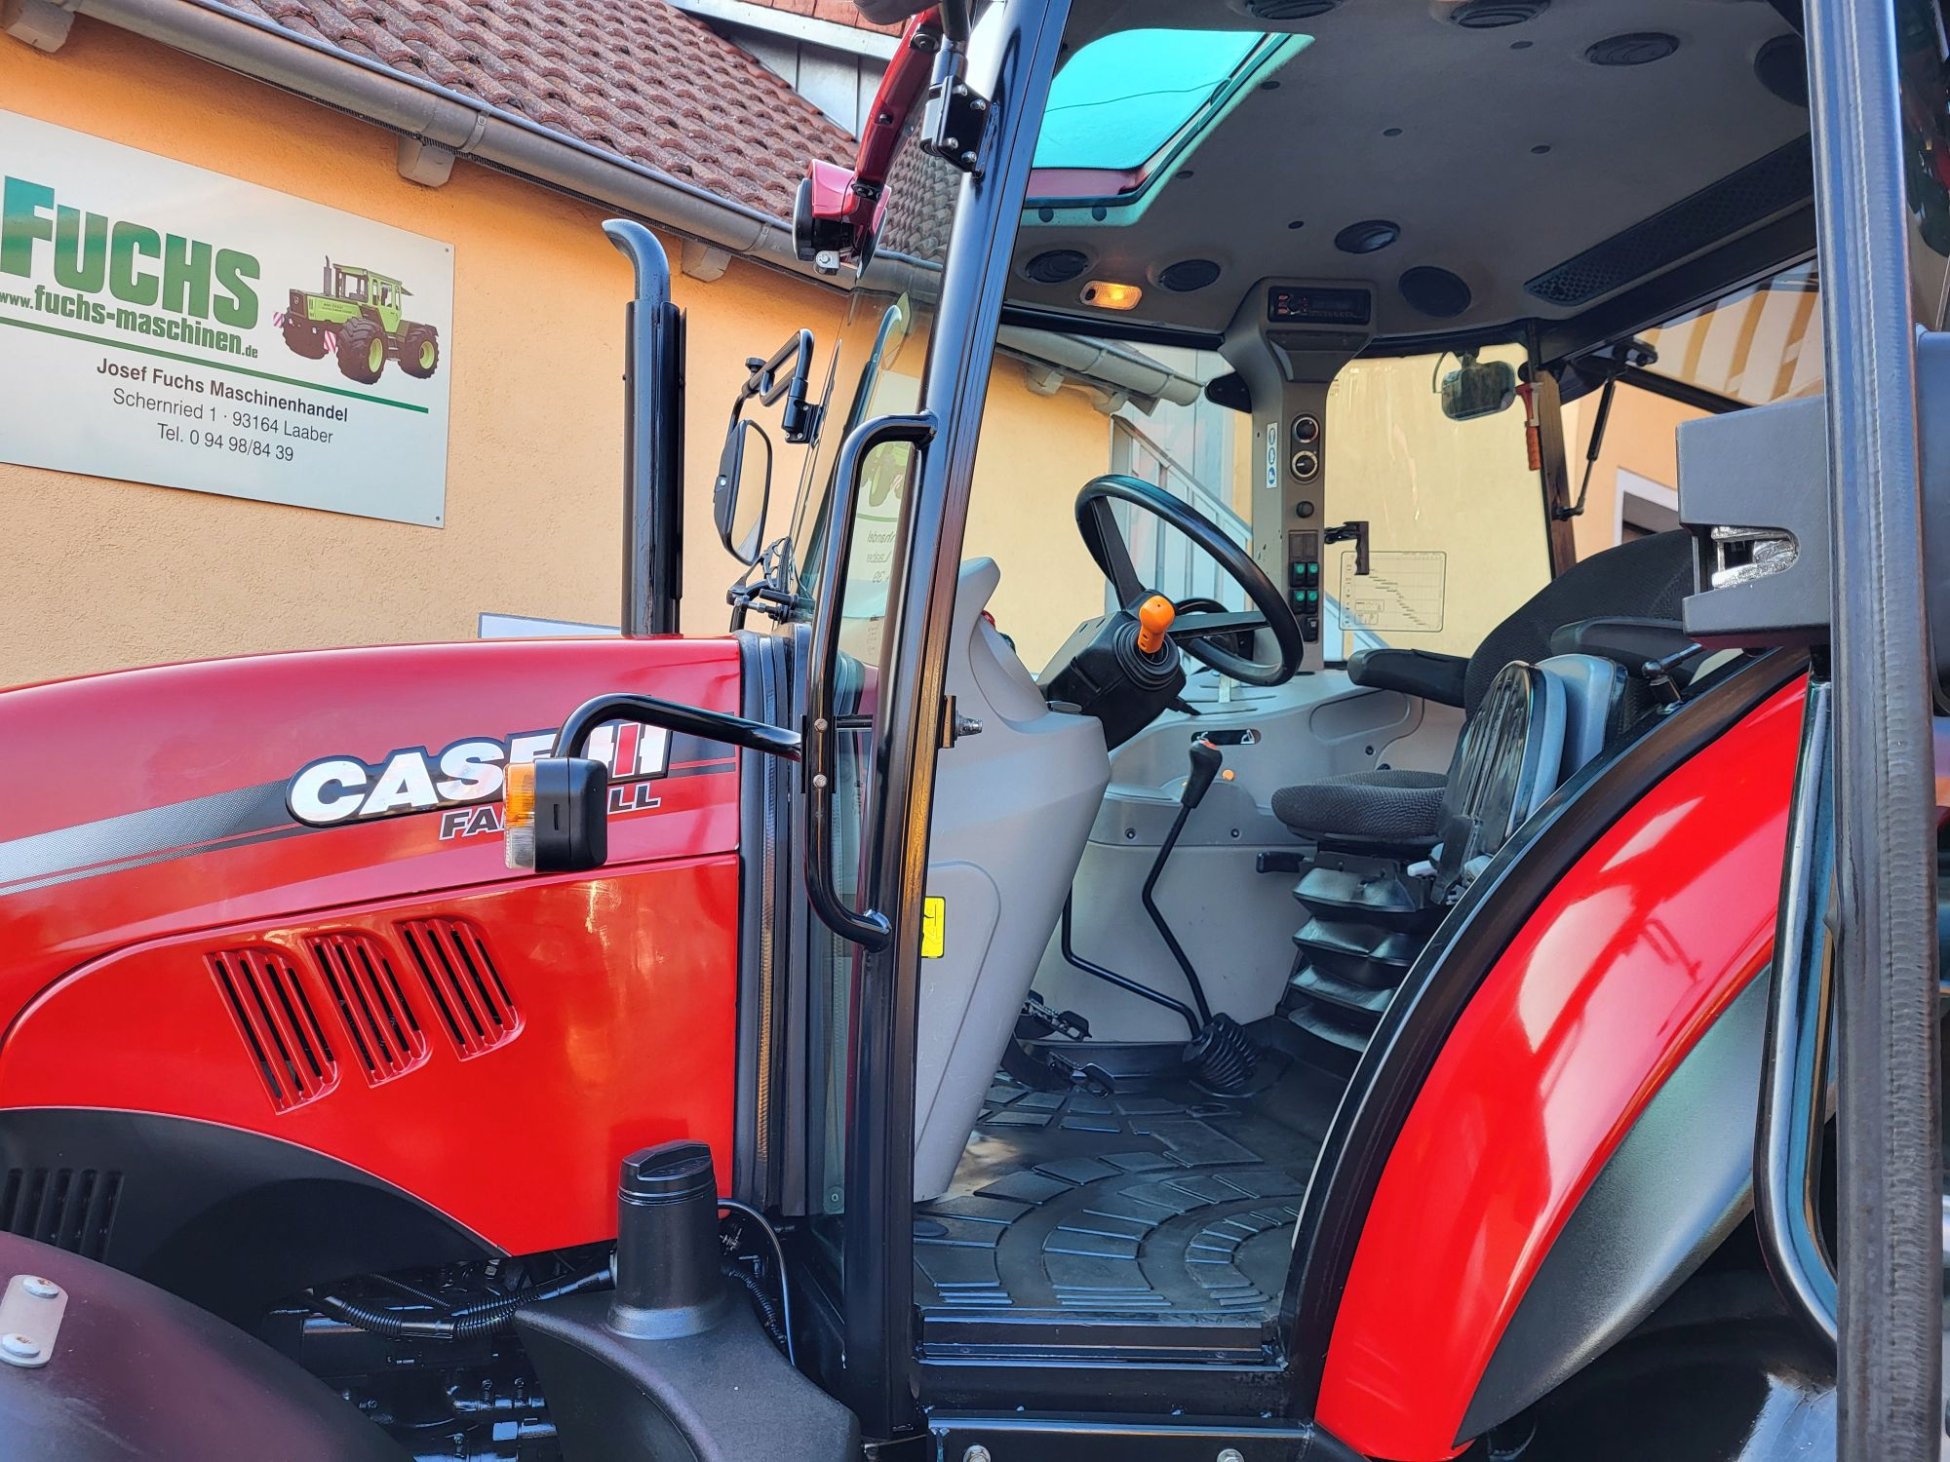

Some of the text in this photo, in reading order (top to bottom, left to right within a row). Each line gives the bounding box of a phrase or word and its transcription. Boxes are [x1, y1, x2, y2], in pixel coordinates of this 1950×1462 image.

[0, 175, 261, 330] FUCHS
[0, 284, 259, 359] www.fuchs-maschinen.de
[97, 358, 348, 423] Josef Fuchs Maschinenhandel
[113, 388, 334, 444] Schernried 1 93164 Laaber
[157, 422, 294, 462] Tel. 0 94 98/84 39
